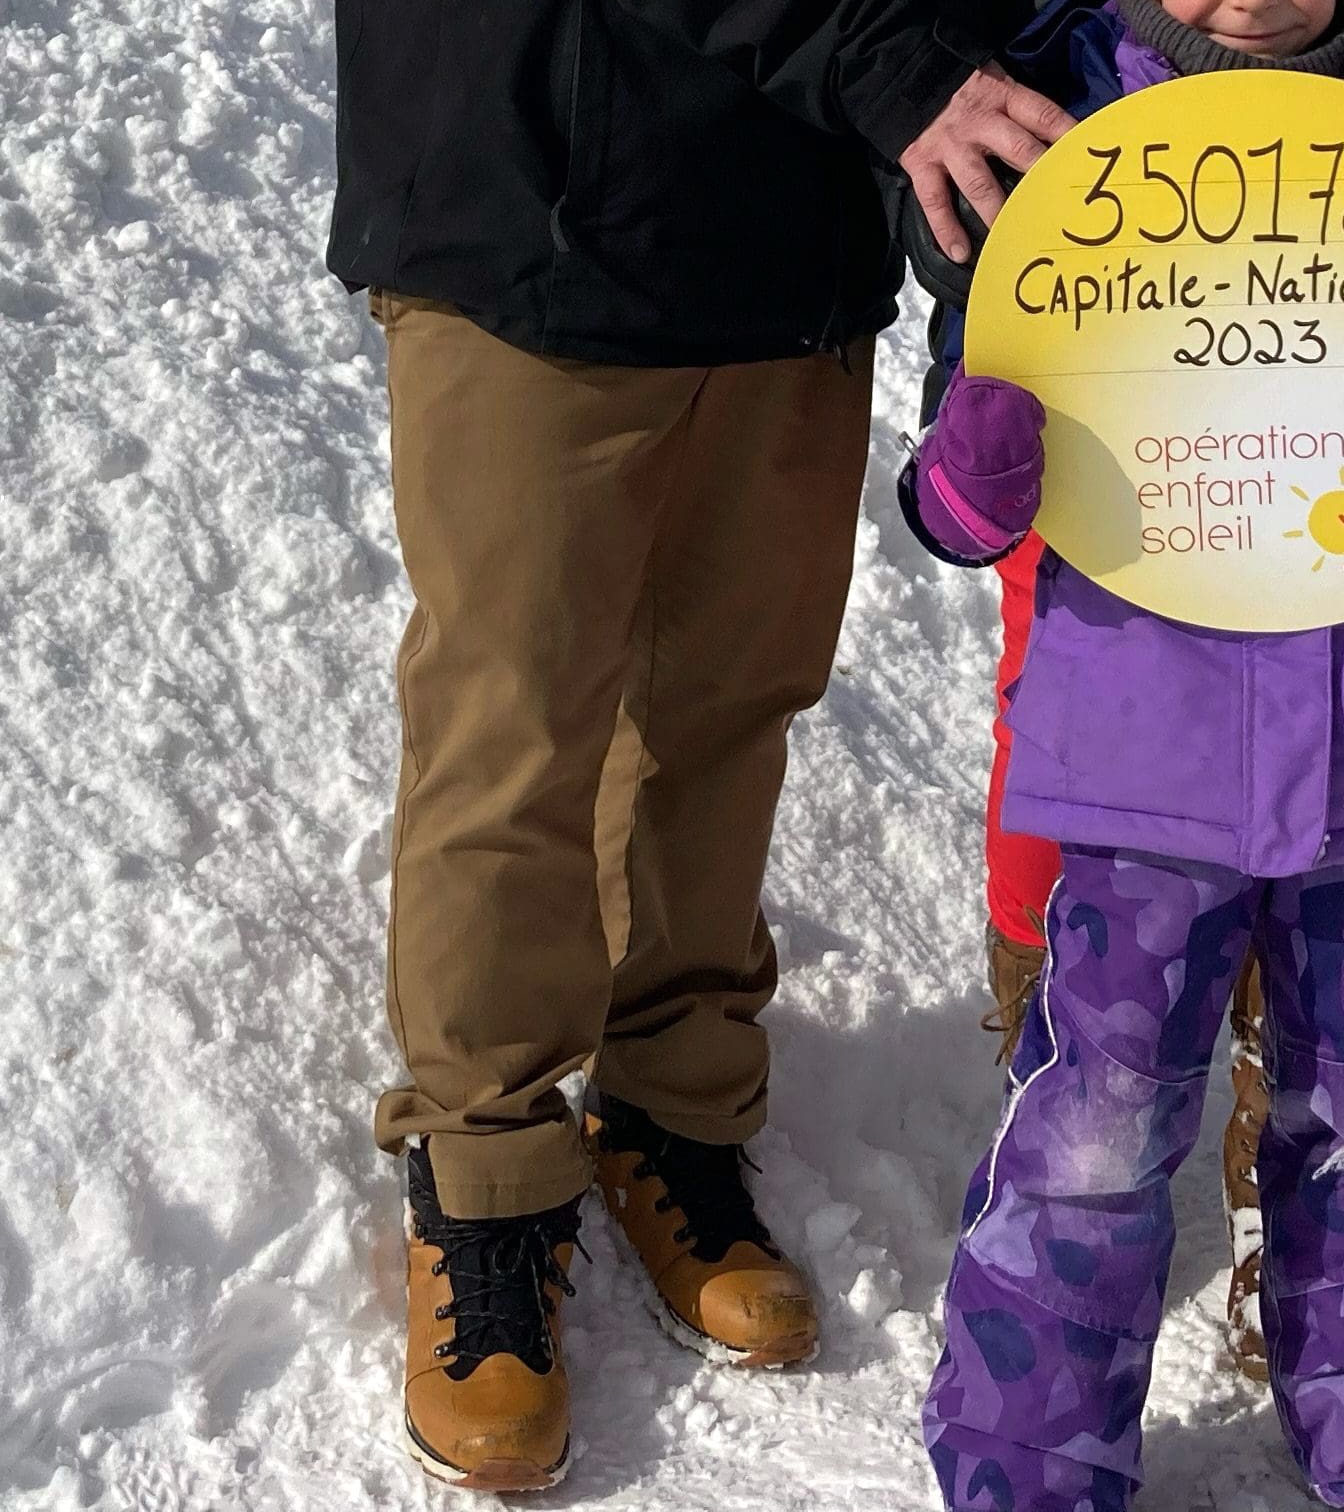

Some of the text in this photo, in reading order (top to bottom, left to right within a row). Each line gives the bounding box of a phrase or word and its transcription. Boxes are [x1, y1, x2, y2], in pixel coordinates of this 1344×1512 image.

[1173, 317, 1328, 367] 2023
[1137, 470, 1276, 509] enfant
[1140, 515, 1253, 554] soleil
